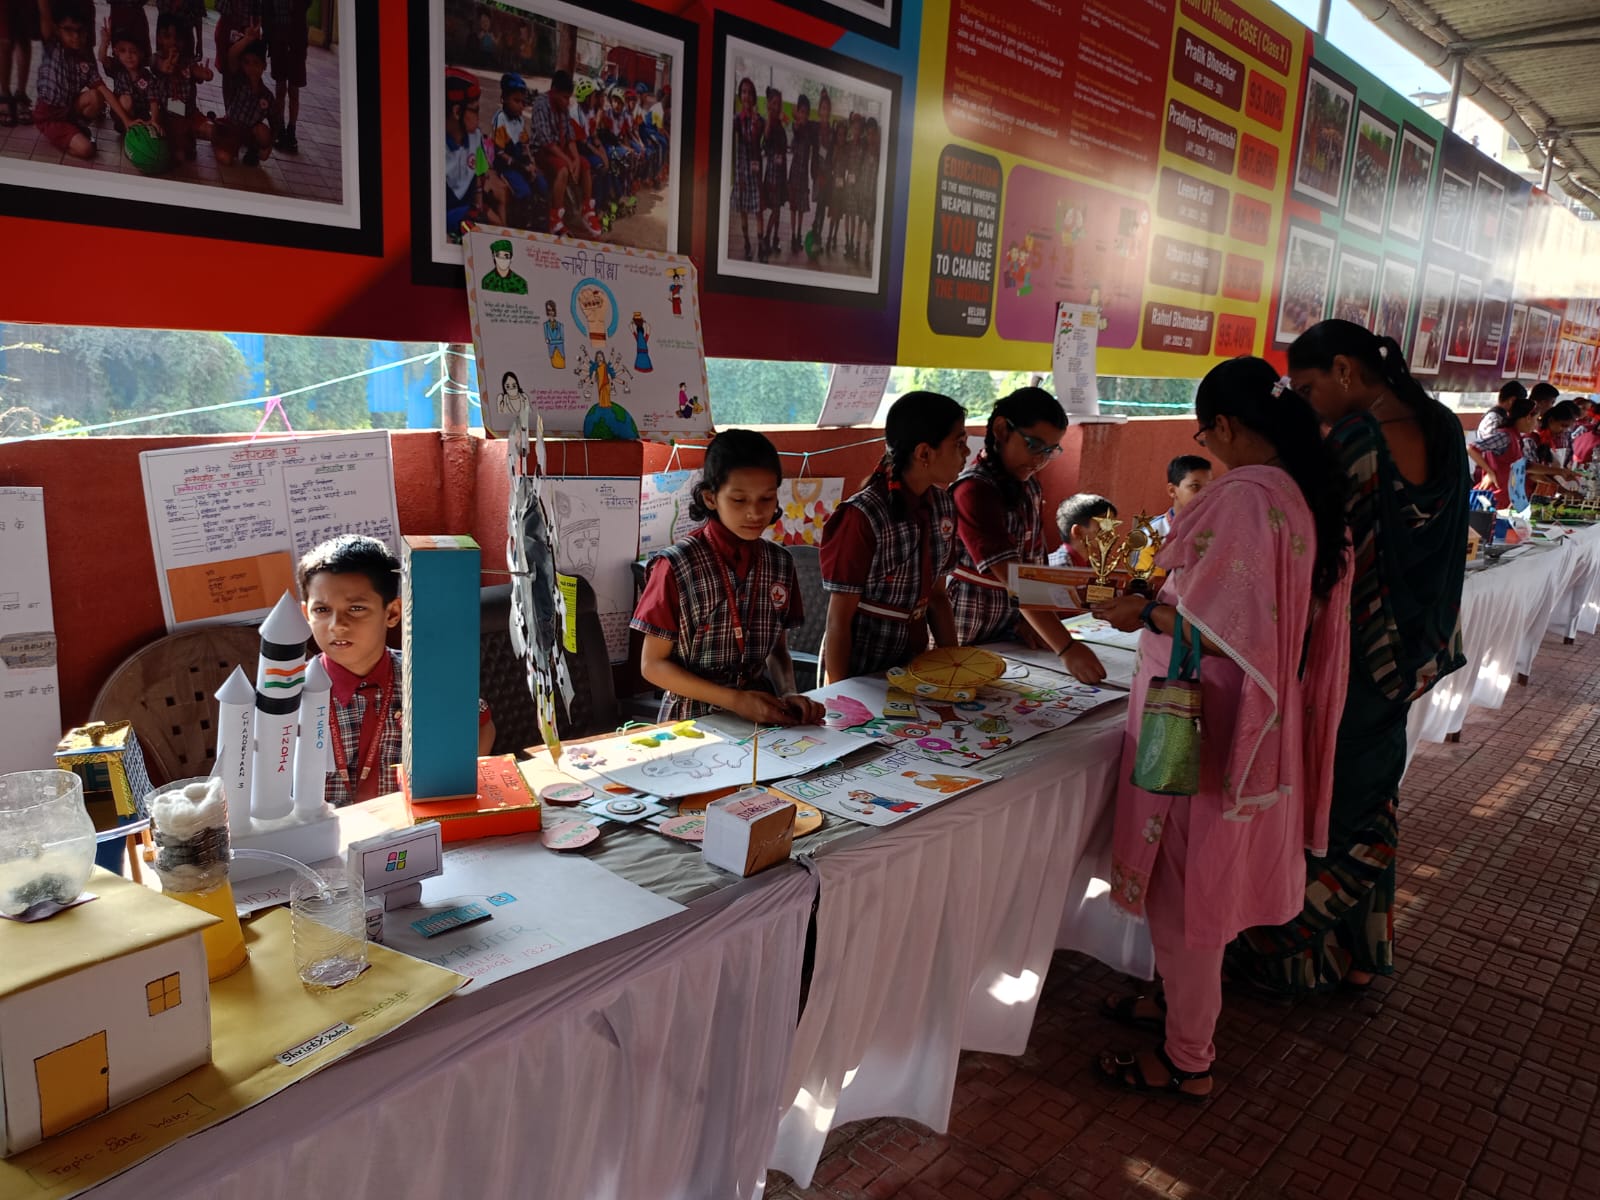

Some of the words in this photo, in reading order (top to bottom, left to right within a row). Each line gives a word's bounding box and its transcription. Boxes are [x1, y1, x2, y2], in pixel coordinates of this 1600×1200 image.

[1184, 37, 1207, 67] Pratik
[1206, 49, 1238, 82] Bhosekar
[1238, 17, 1259, 47] CBSE
[1261, 33, 1280, 60] Class
[943, 155, 999, 188] EDUCATION
[948, 182, 958, 194] THE
[958, 184, 972, 197] MOST
[972, 187, 998, 203] POWERFUL
[941, 194, 972, 216] WEAPON
[972, 202, 996, 220] WHICH
[940, 213, 977, 256] YOU
[977, 221, 994, 240] CAN
[975, 241, 993, 259] USE
[935, 279, 954, 299] THE
[936, 254, 950, 275] TO
[952, 256, 991, 282] CHANGE
[277, 724, 293, 773] INDIA
[316, 705, 326, 750] ISRO
[429, 924, 535, 967] OMPUTER
[47, 1152, 96, 1176] Topic
[148, 1108, 191, 1129] Water
